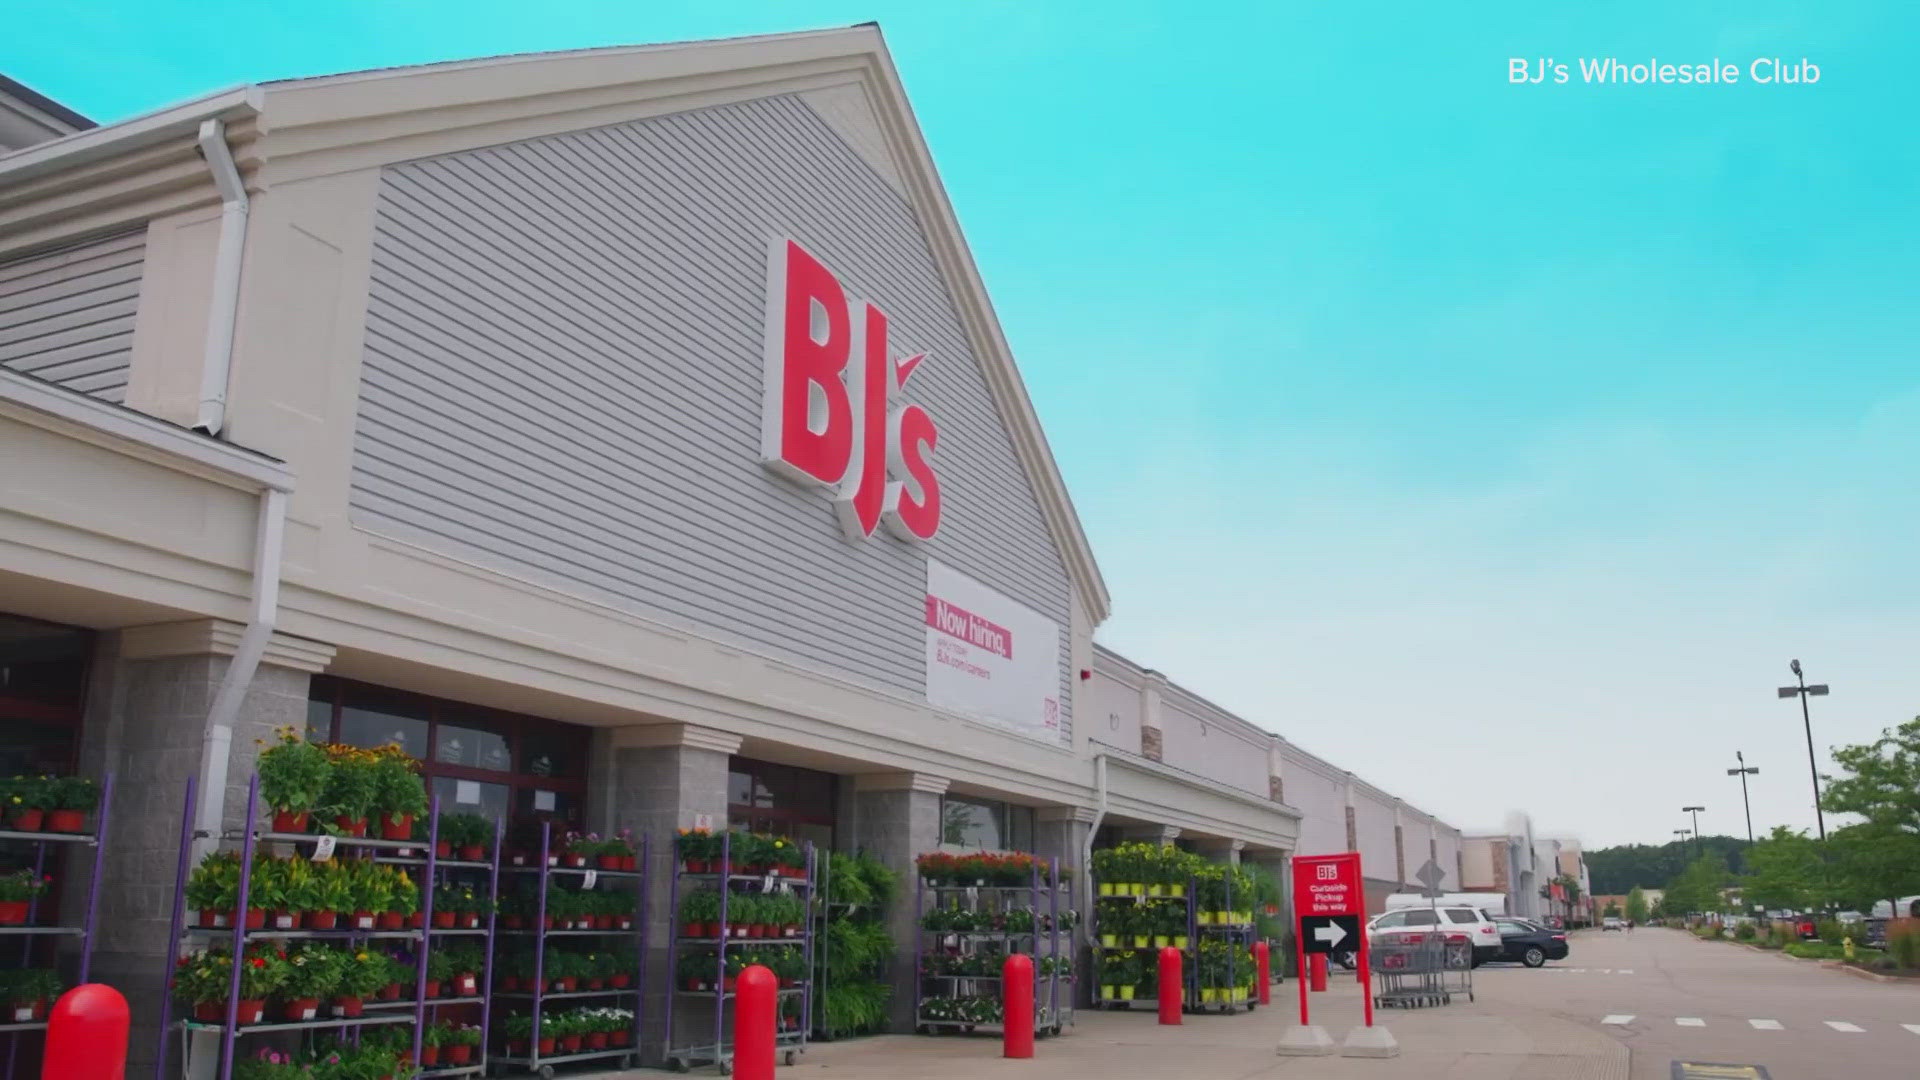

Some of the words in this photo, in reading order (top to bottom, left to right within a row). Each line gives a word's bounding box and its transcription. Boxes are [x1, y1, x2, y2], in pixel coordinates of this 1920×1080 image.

[780, 238, 942, 540] BJ's
[936, 600, 967, 638] Now
[969, 615, 1007, 656] hiring.
[1310, 884, 1347, 893] Curbside
[1315, 893, 1344, 902] Pickup
[1312, 903, 1328, 912] this
[1330, 903, 1347, 912] way
